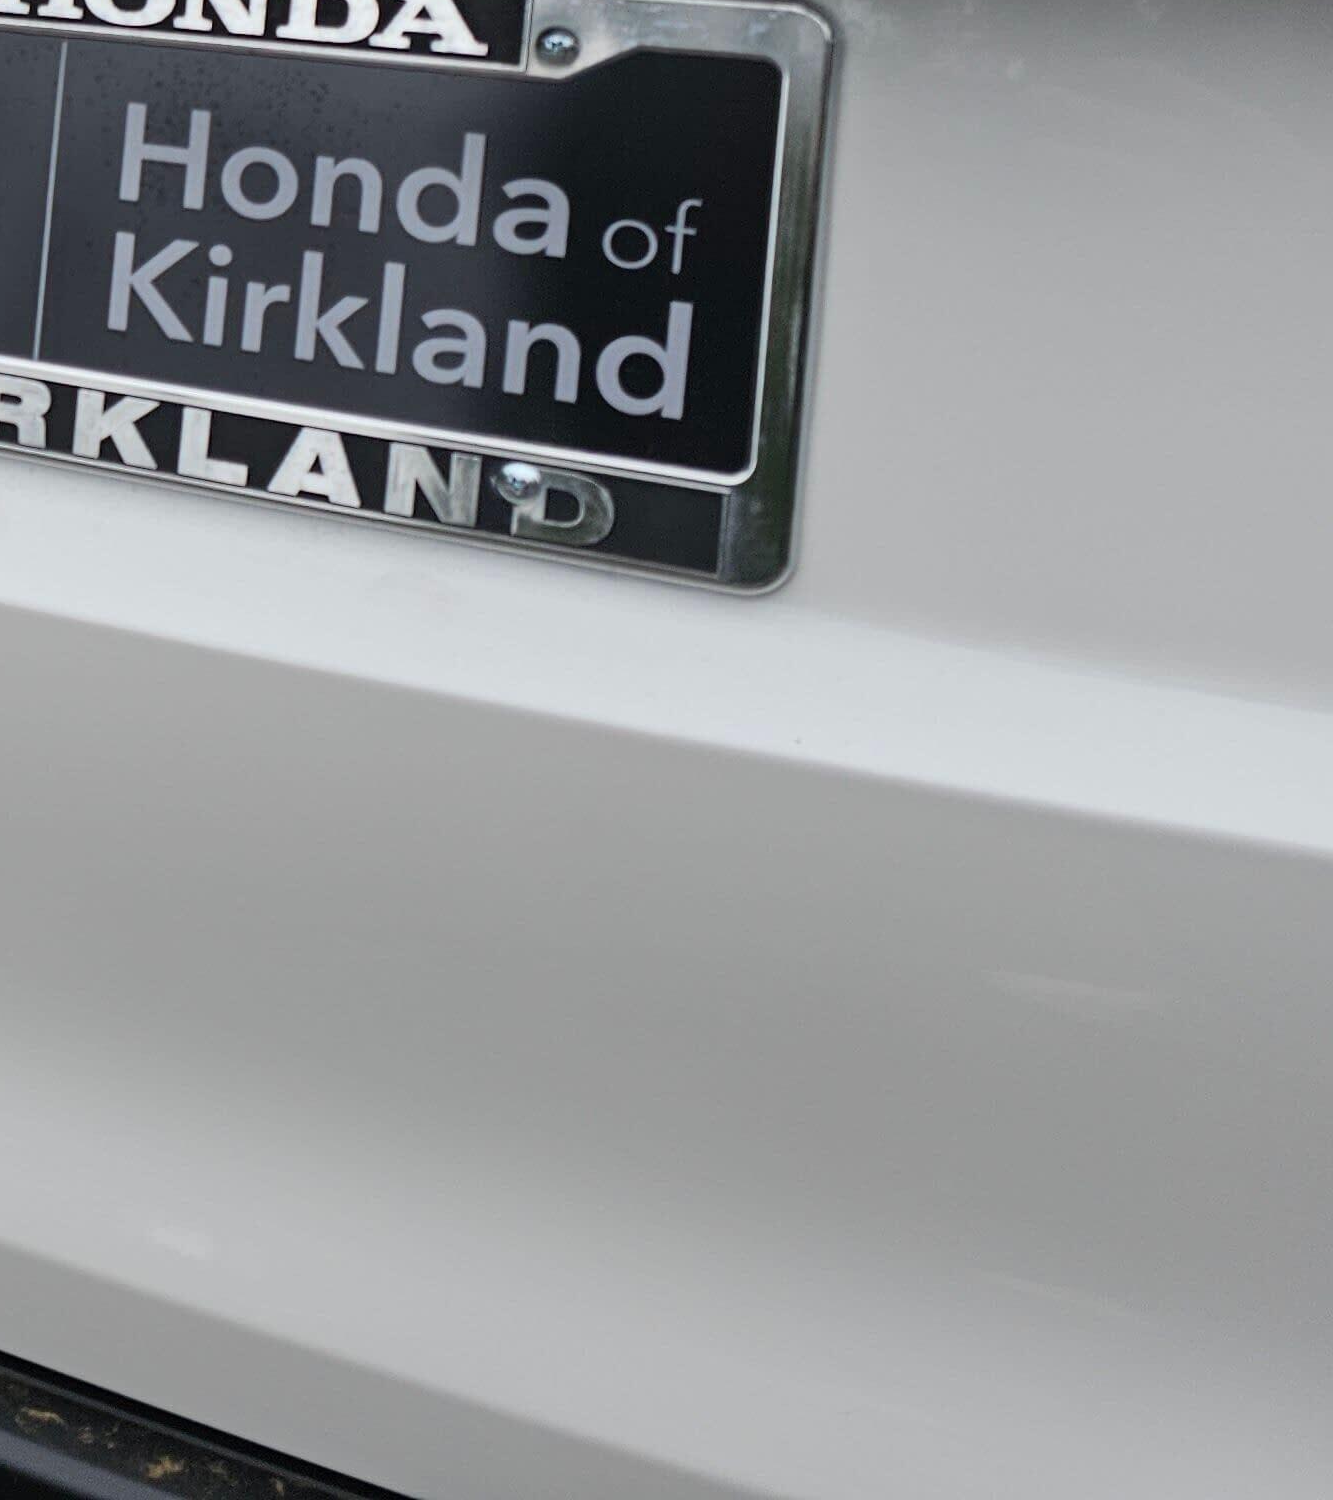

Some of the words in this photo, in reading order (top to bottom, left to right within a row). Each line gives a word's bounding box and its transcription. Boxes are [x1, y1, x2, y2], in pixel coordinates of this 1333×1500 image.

[118, 103, 571, 258] Honda
[600, 198, 703, 274] of
[107, 233, 695, 420] Kirkland
